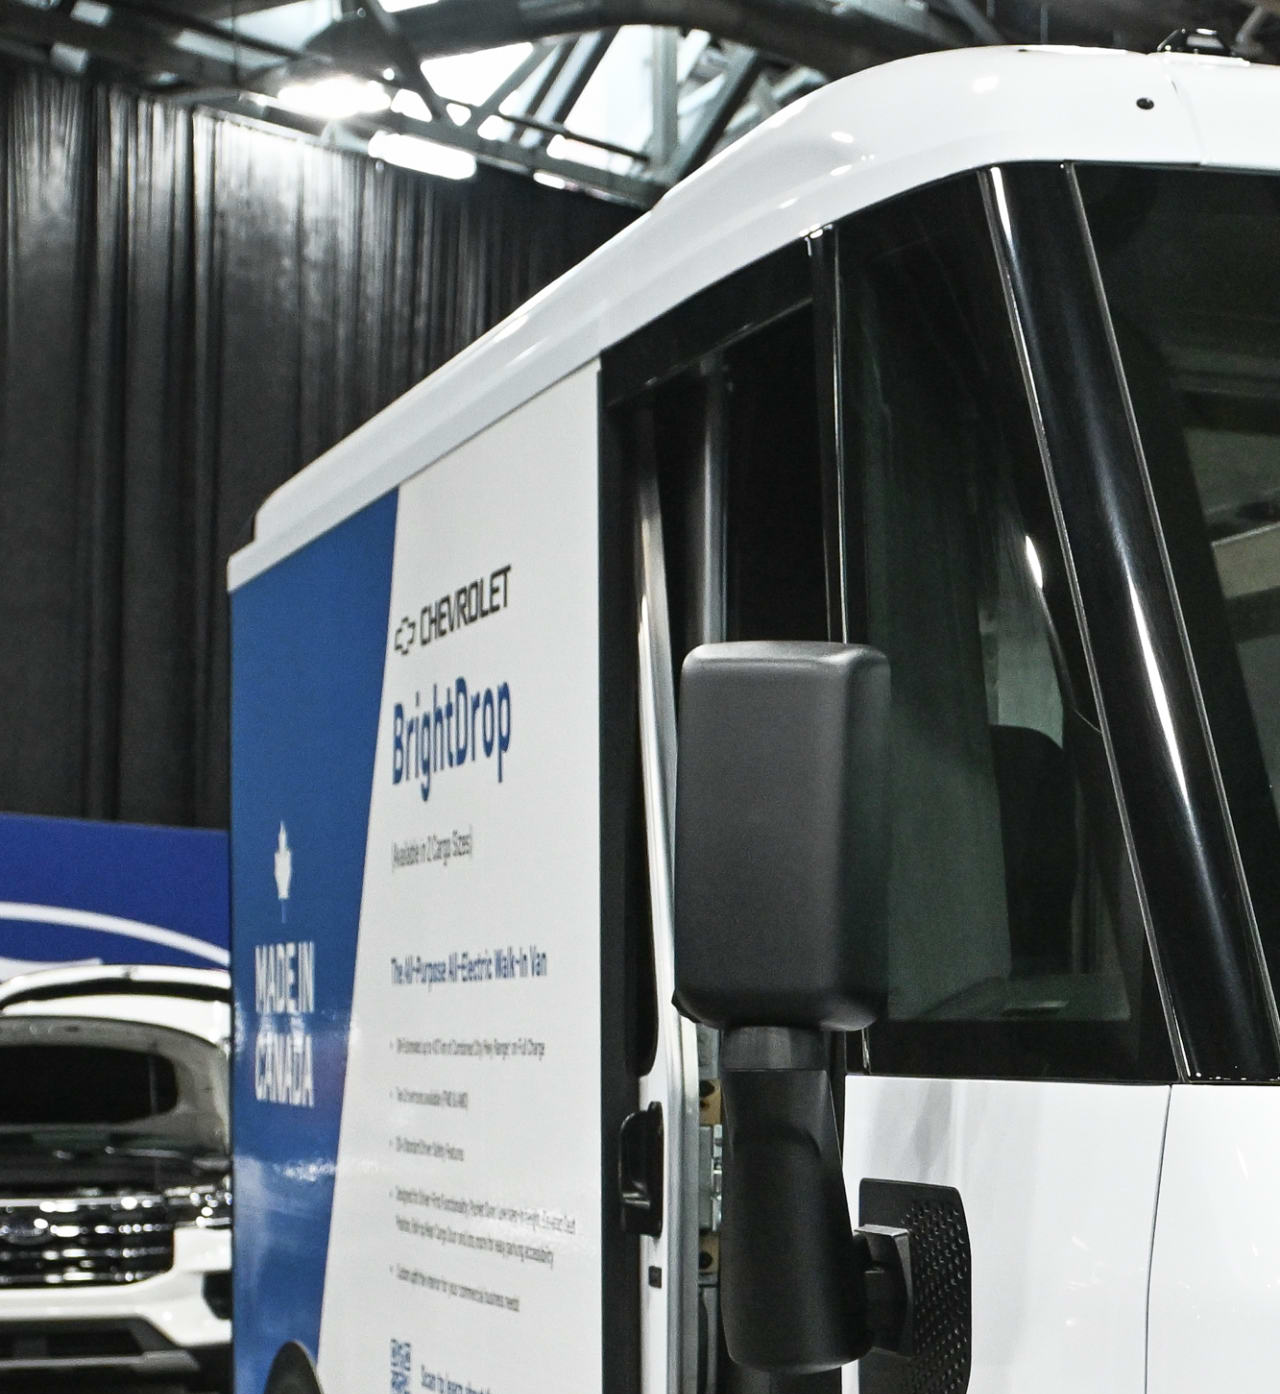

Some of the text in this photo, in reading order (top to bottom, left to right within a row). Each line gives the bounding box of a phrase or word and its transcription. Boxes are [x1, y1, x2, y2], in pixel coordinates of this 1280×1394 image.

[420, 563, 512, 647] CHEVROLET
[393, 676, 511, 802] BrightDrop
[255, 941, 315, 1014] MADE IN
[391, 957, 403, 985] The
[405, 953, 446, 992] All-Purpose
[449, 948, 493, 983] All-Electric
[530, 945, 548, 977] Van
[254, 1032, 315, 1108] CANADA
[421, 1364, 436, 1392] Scan
